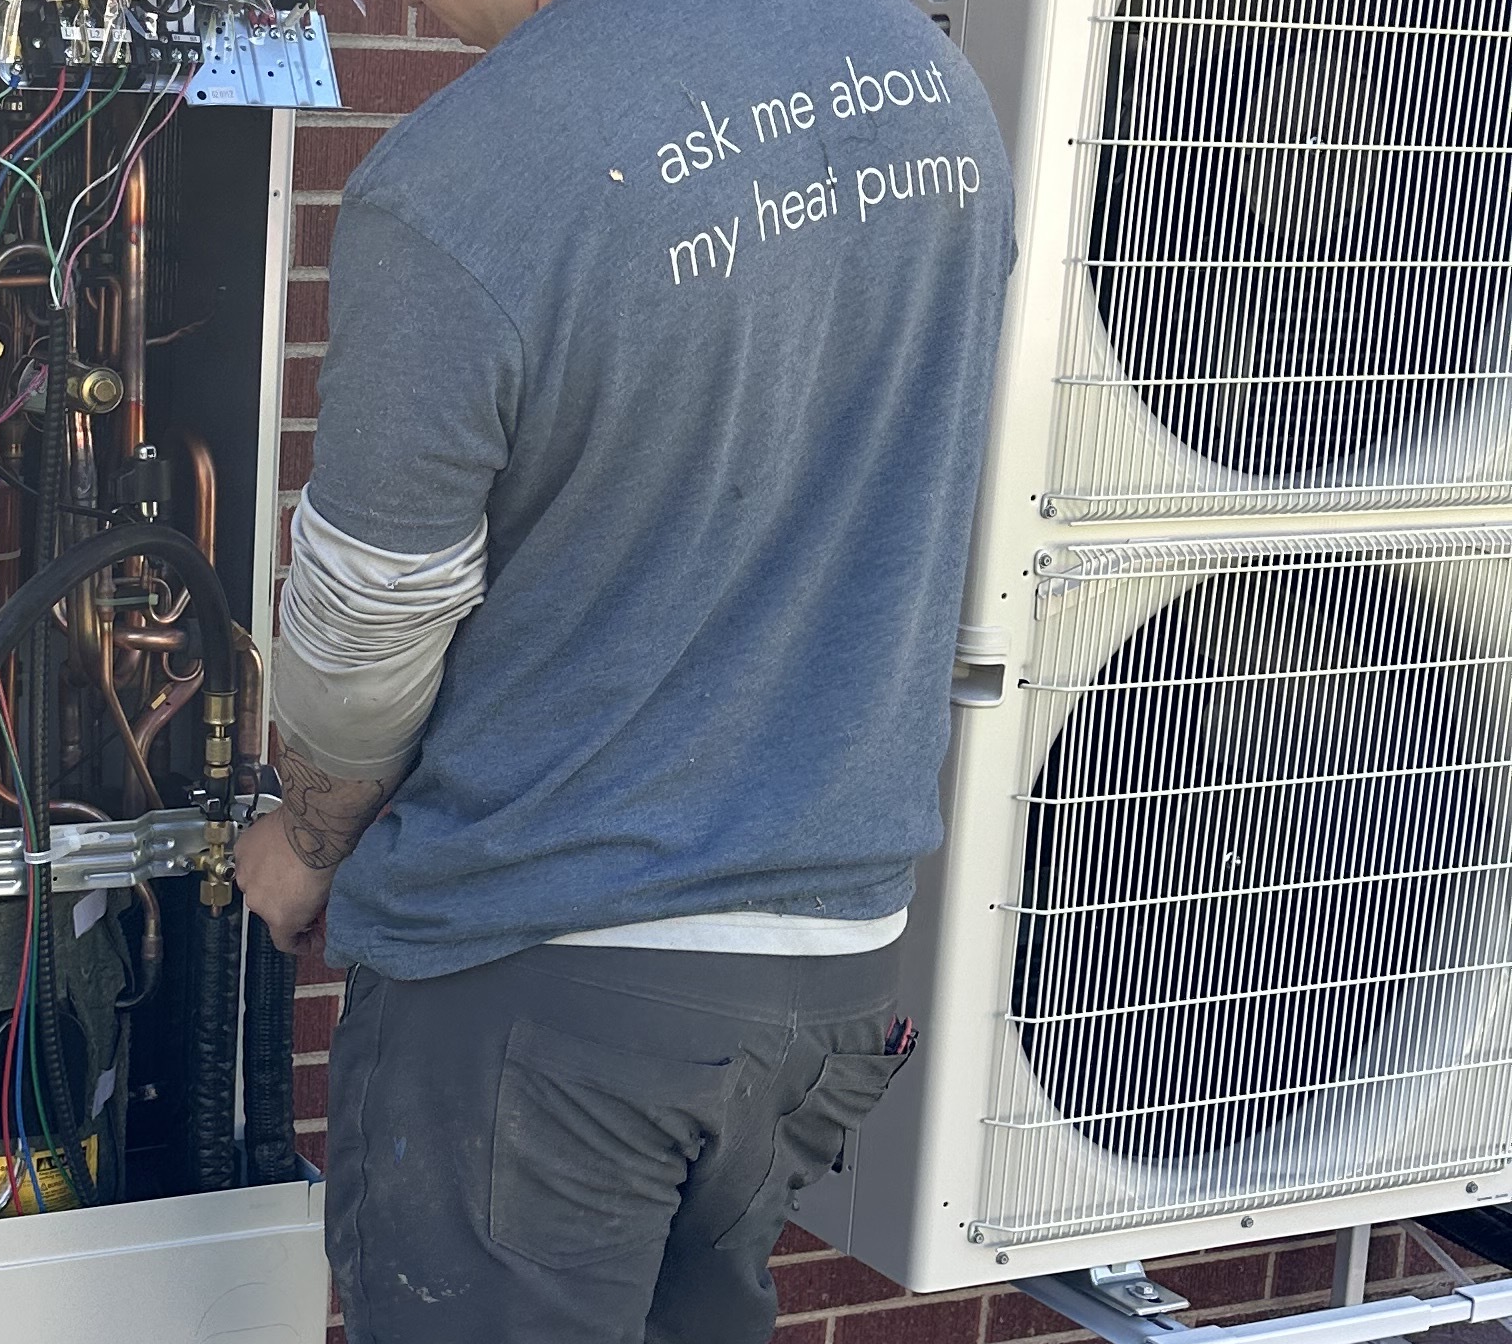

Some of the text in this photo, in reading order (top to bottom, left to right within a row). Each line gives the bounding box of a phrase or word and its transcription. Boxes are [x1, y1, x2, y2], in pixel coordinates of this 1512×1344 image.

[656, 55, 951, 184] ask me about
[669, 155, 981, 285] my heat pump
